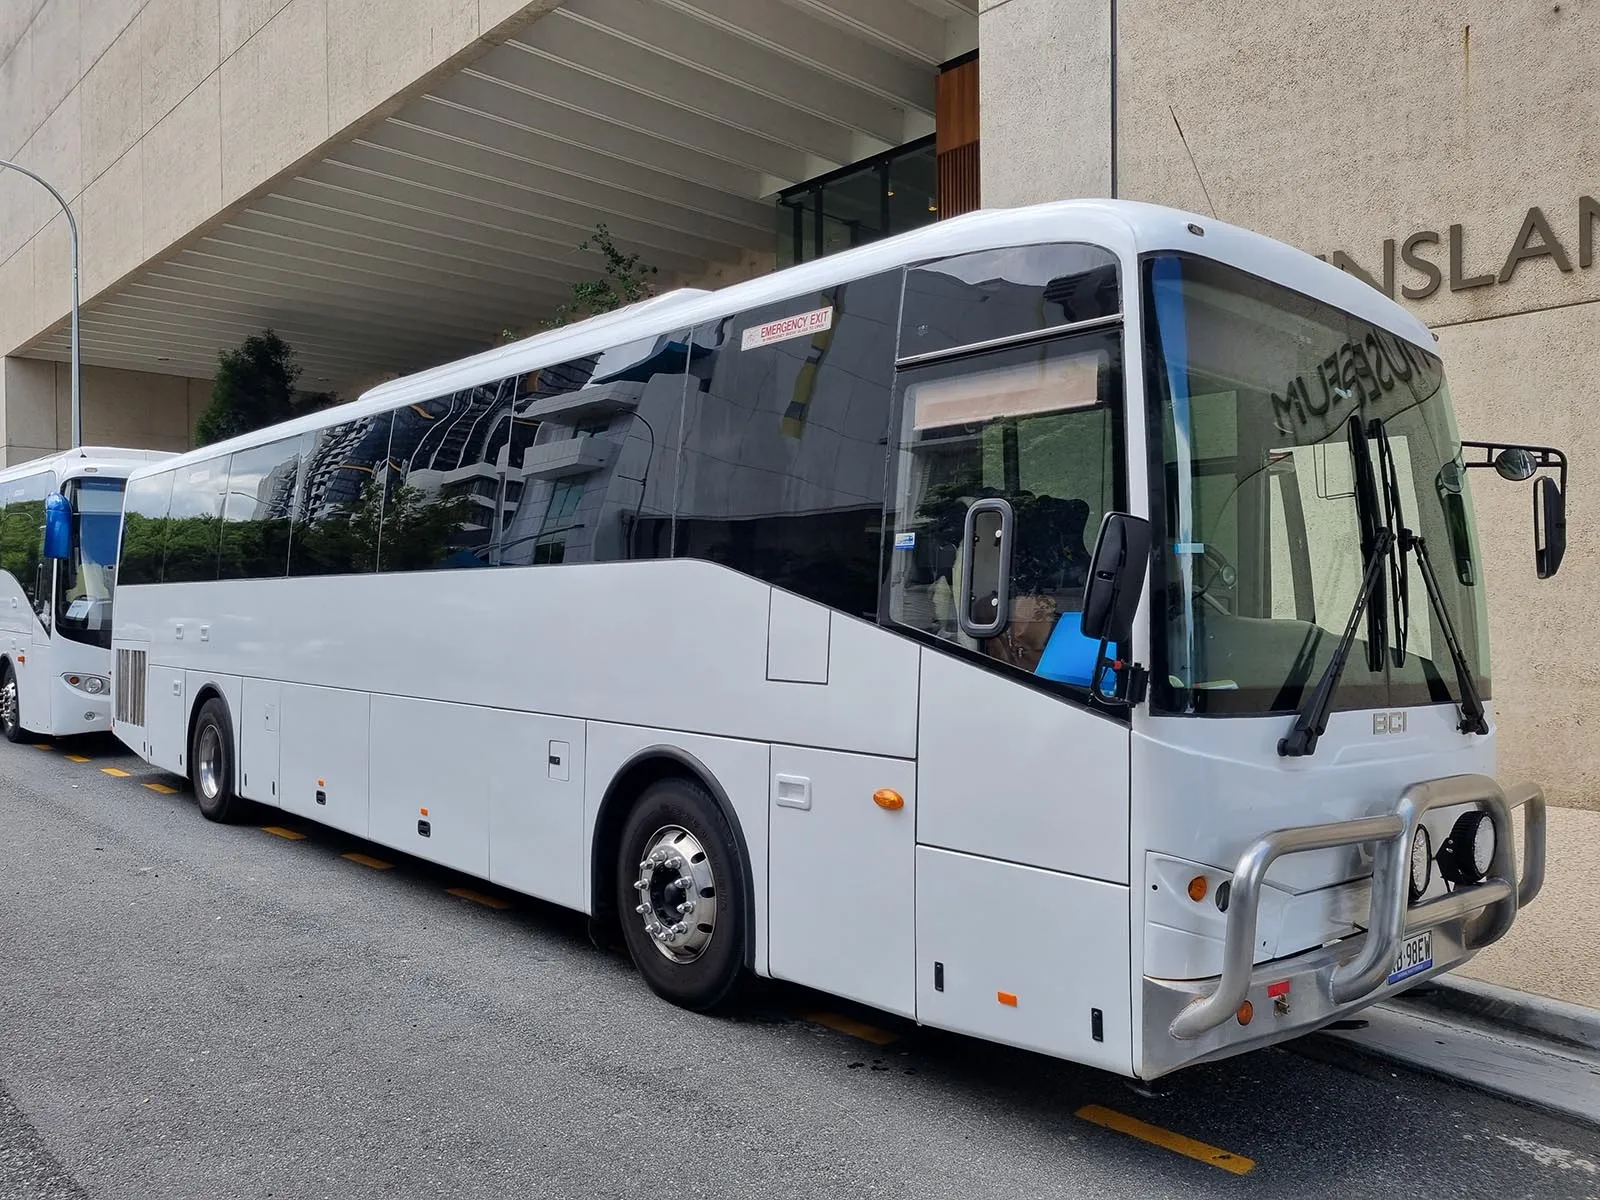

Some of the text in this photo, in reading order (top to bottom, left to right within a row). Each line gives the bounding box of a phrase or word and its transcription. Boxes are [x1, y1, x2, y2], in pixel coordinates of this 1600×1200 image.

[760, 316, 808, 338] EMERGENCY
[810, 310, 829, 326] EXIT
[1373, 711, 1407, 735] BCI
